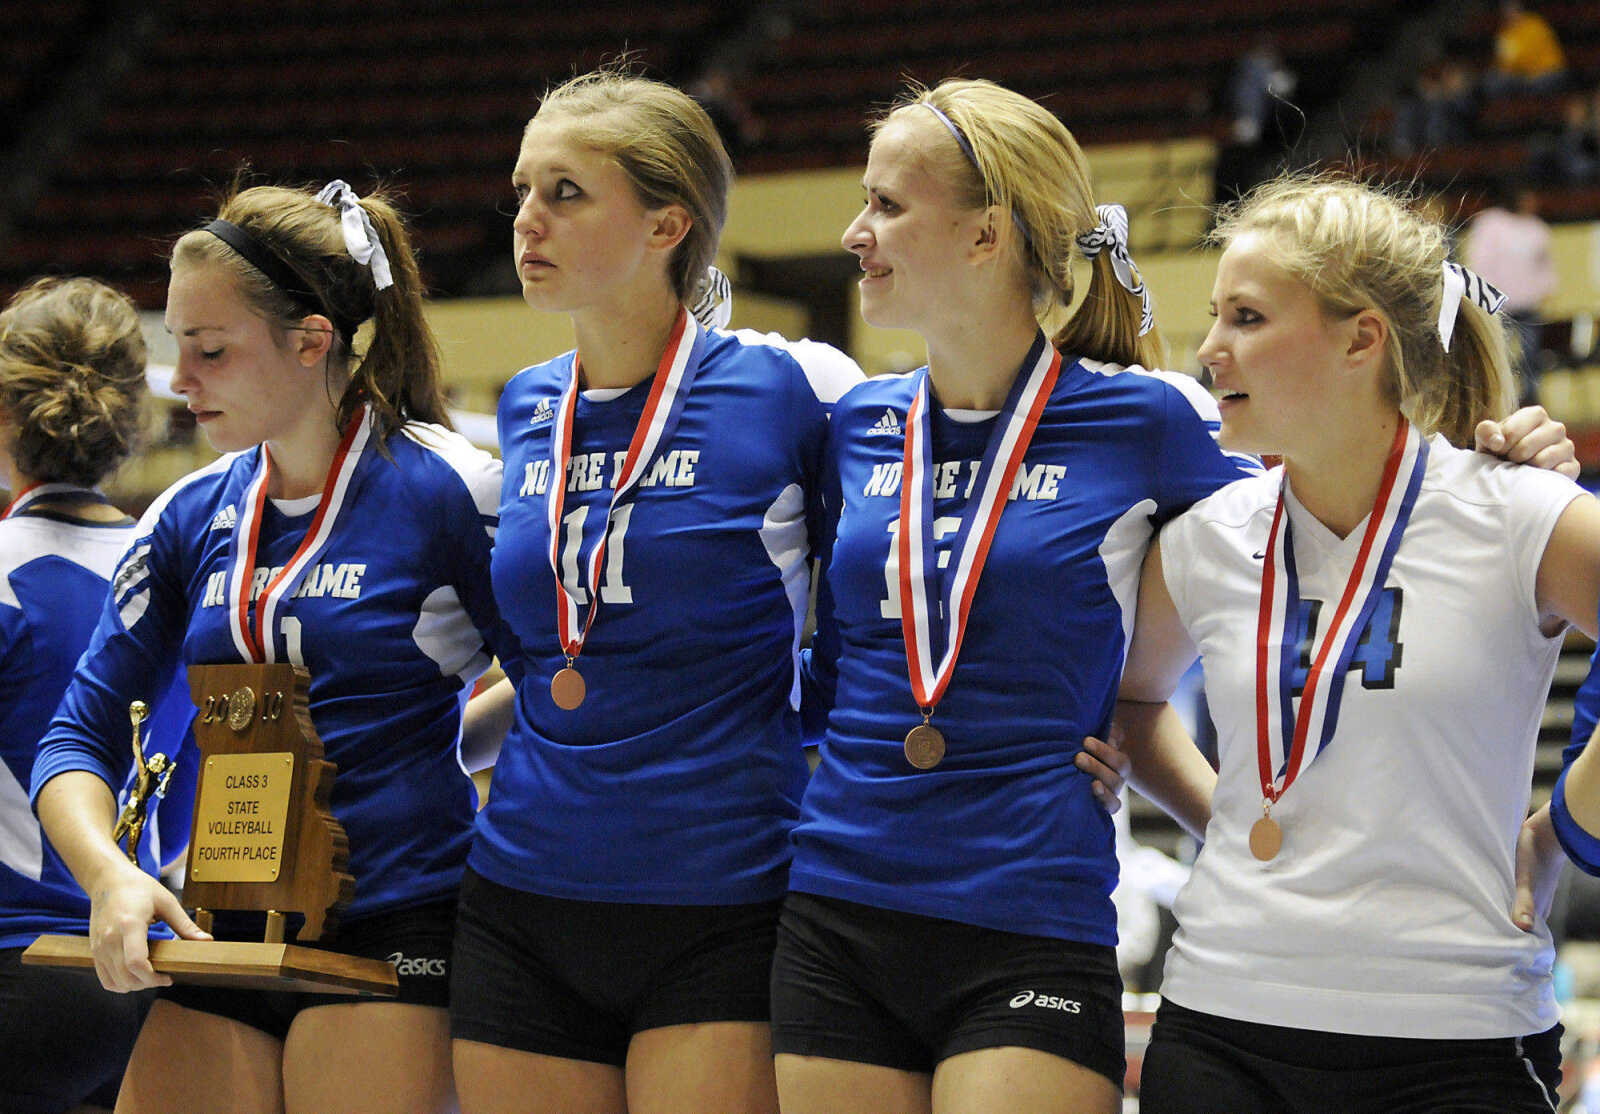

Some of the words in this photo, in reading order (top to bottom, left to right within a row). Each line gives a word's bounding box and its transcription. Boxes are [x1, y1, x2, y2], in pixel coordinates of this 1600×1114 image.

[866, 424, 902, 435] adidas
[519, 452, 606, 498] NORE
[610, 450, 700, 488] DME
[863, 461, 961, 498] NOE
[964, 461, 1067, 501] ME
[562, 503, 634, 605] 11
[290, 563, 367, 600] AME
[225, 775, 260, 789] CLASS
[261, 774, 269, 789] 3
[227, 800, 260, 815] STATE
[208, 820, 273, 835] VOLLEYBALL
[198, 846, 241, 861] FOURTH
[242, 845, 277, 860] PLACE
[398, 957, 446, 976] asics
[1033, 994, 1082, 1014] asics
